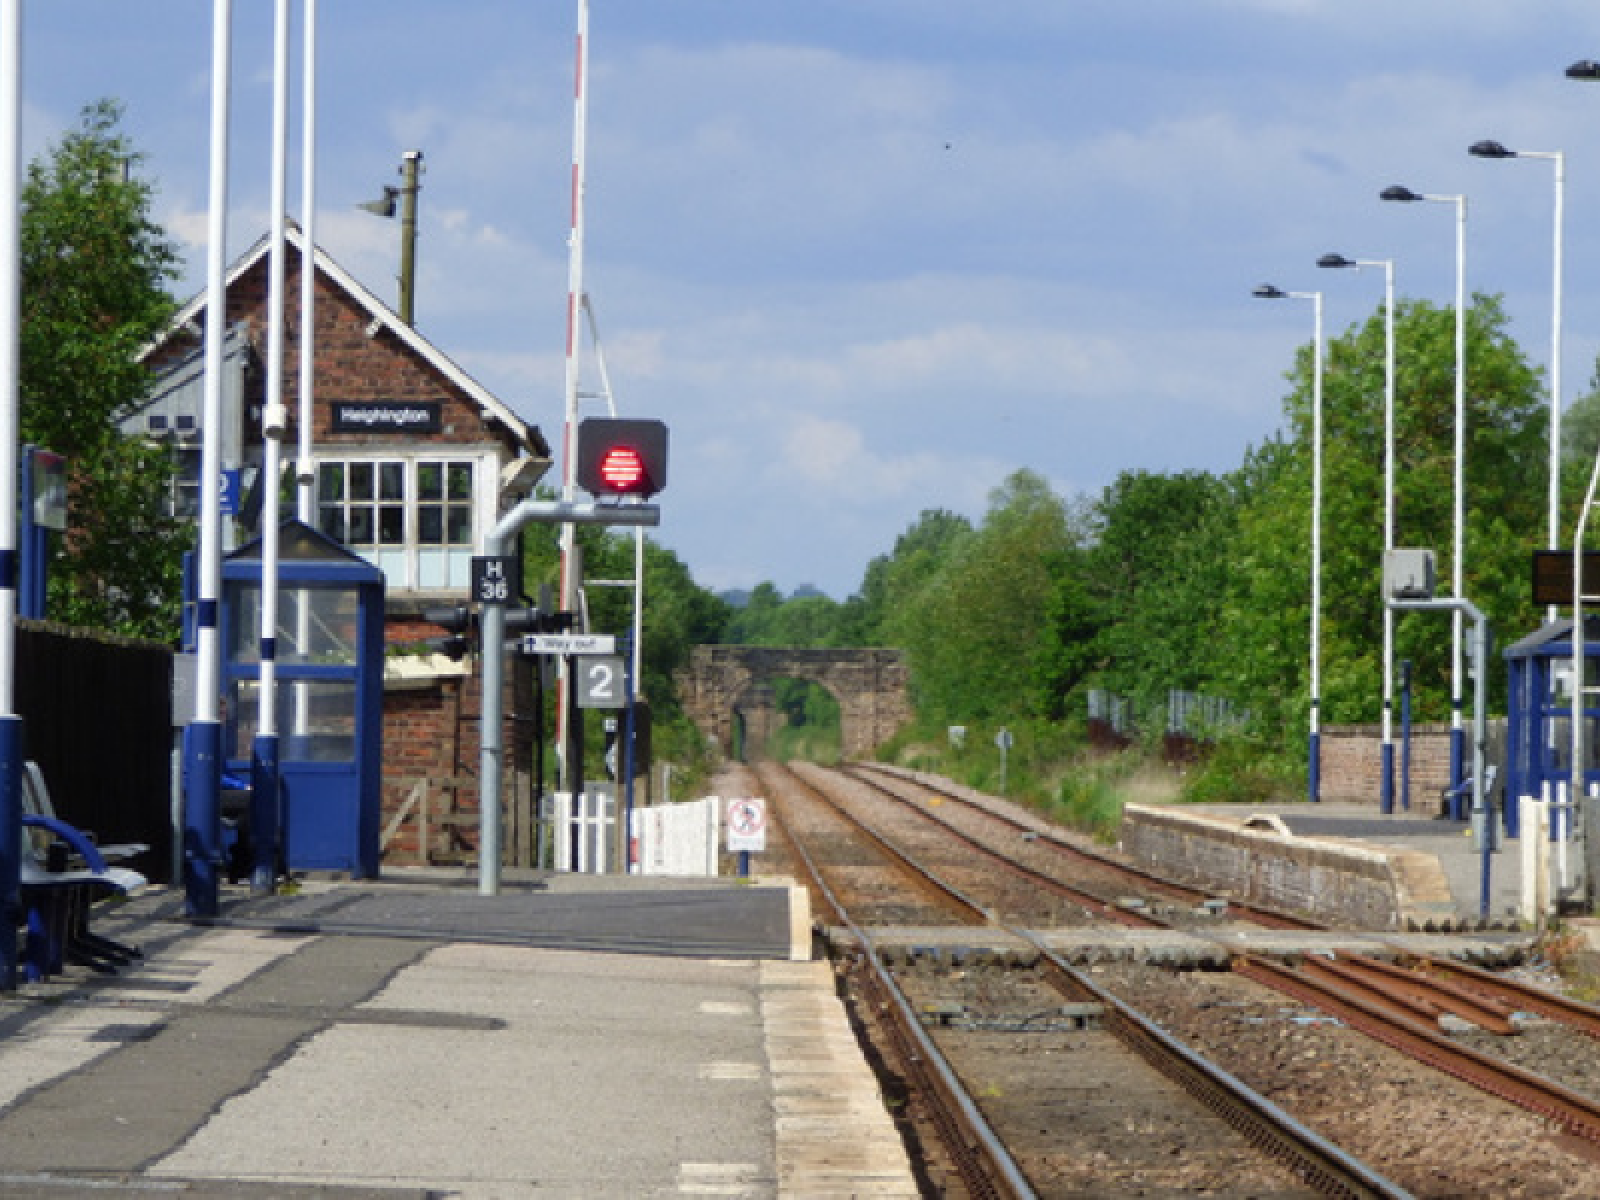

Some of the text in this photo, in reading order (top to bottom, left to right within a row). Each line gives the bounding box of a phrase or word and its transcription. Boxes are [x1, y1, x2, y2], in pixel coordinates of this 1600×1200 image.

[341, 406, 431, 426] Heighington
[486, 561, 502, 577] H
[480, 577, 508, 599] 36
[589, 665, 613, 697] 2
